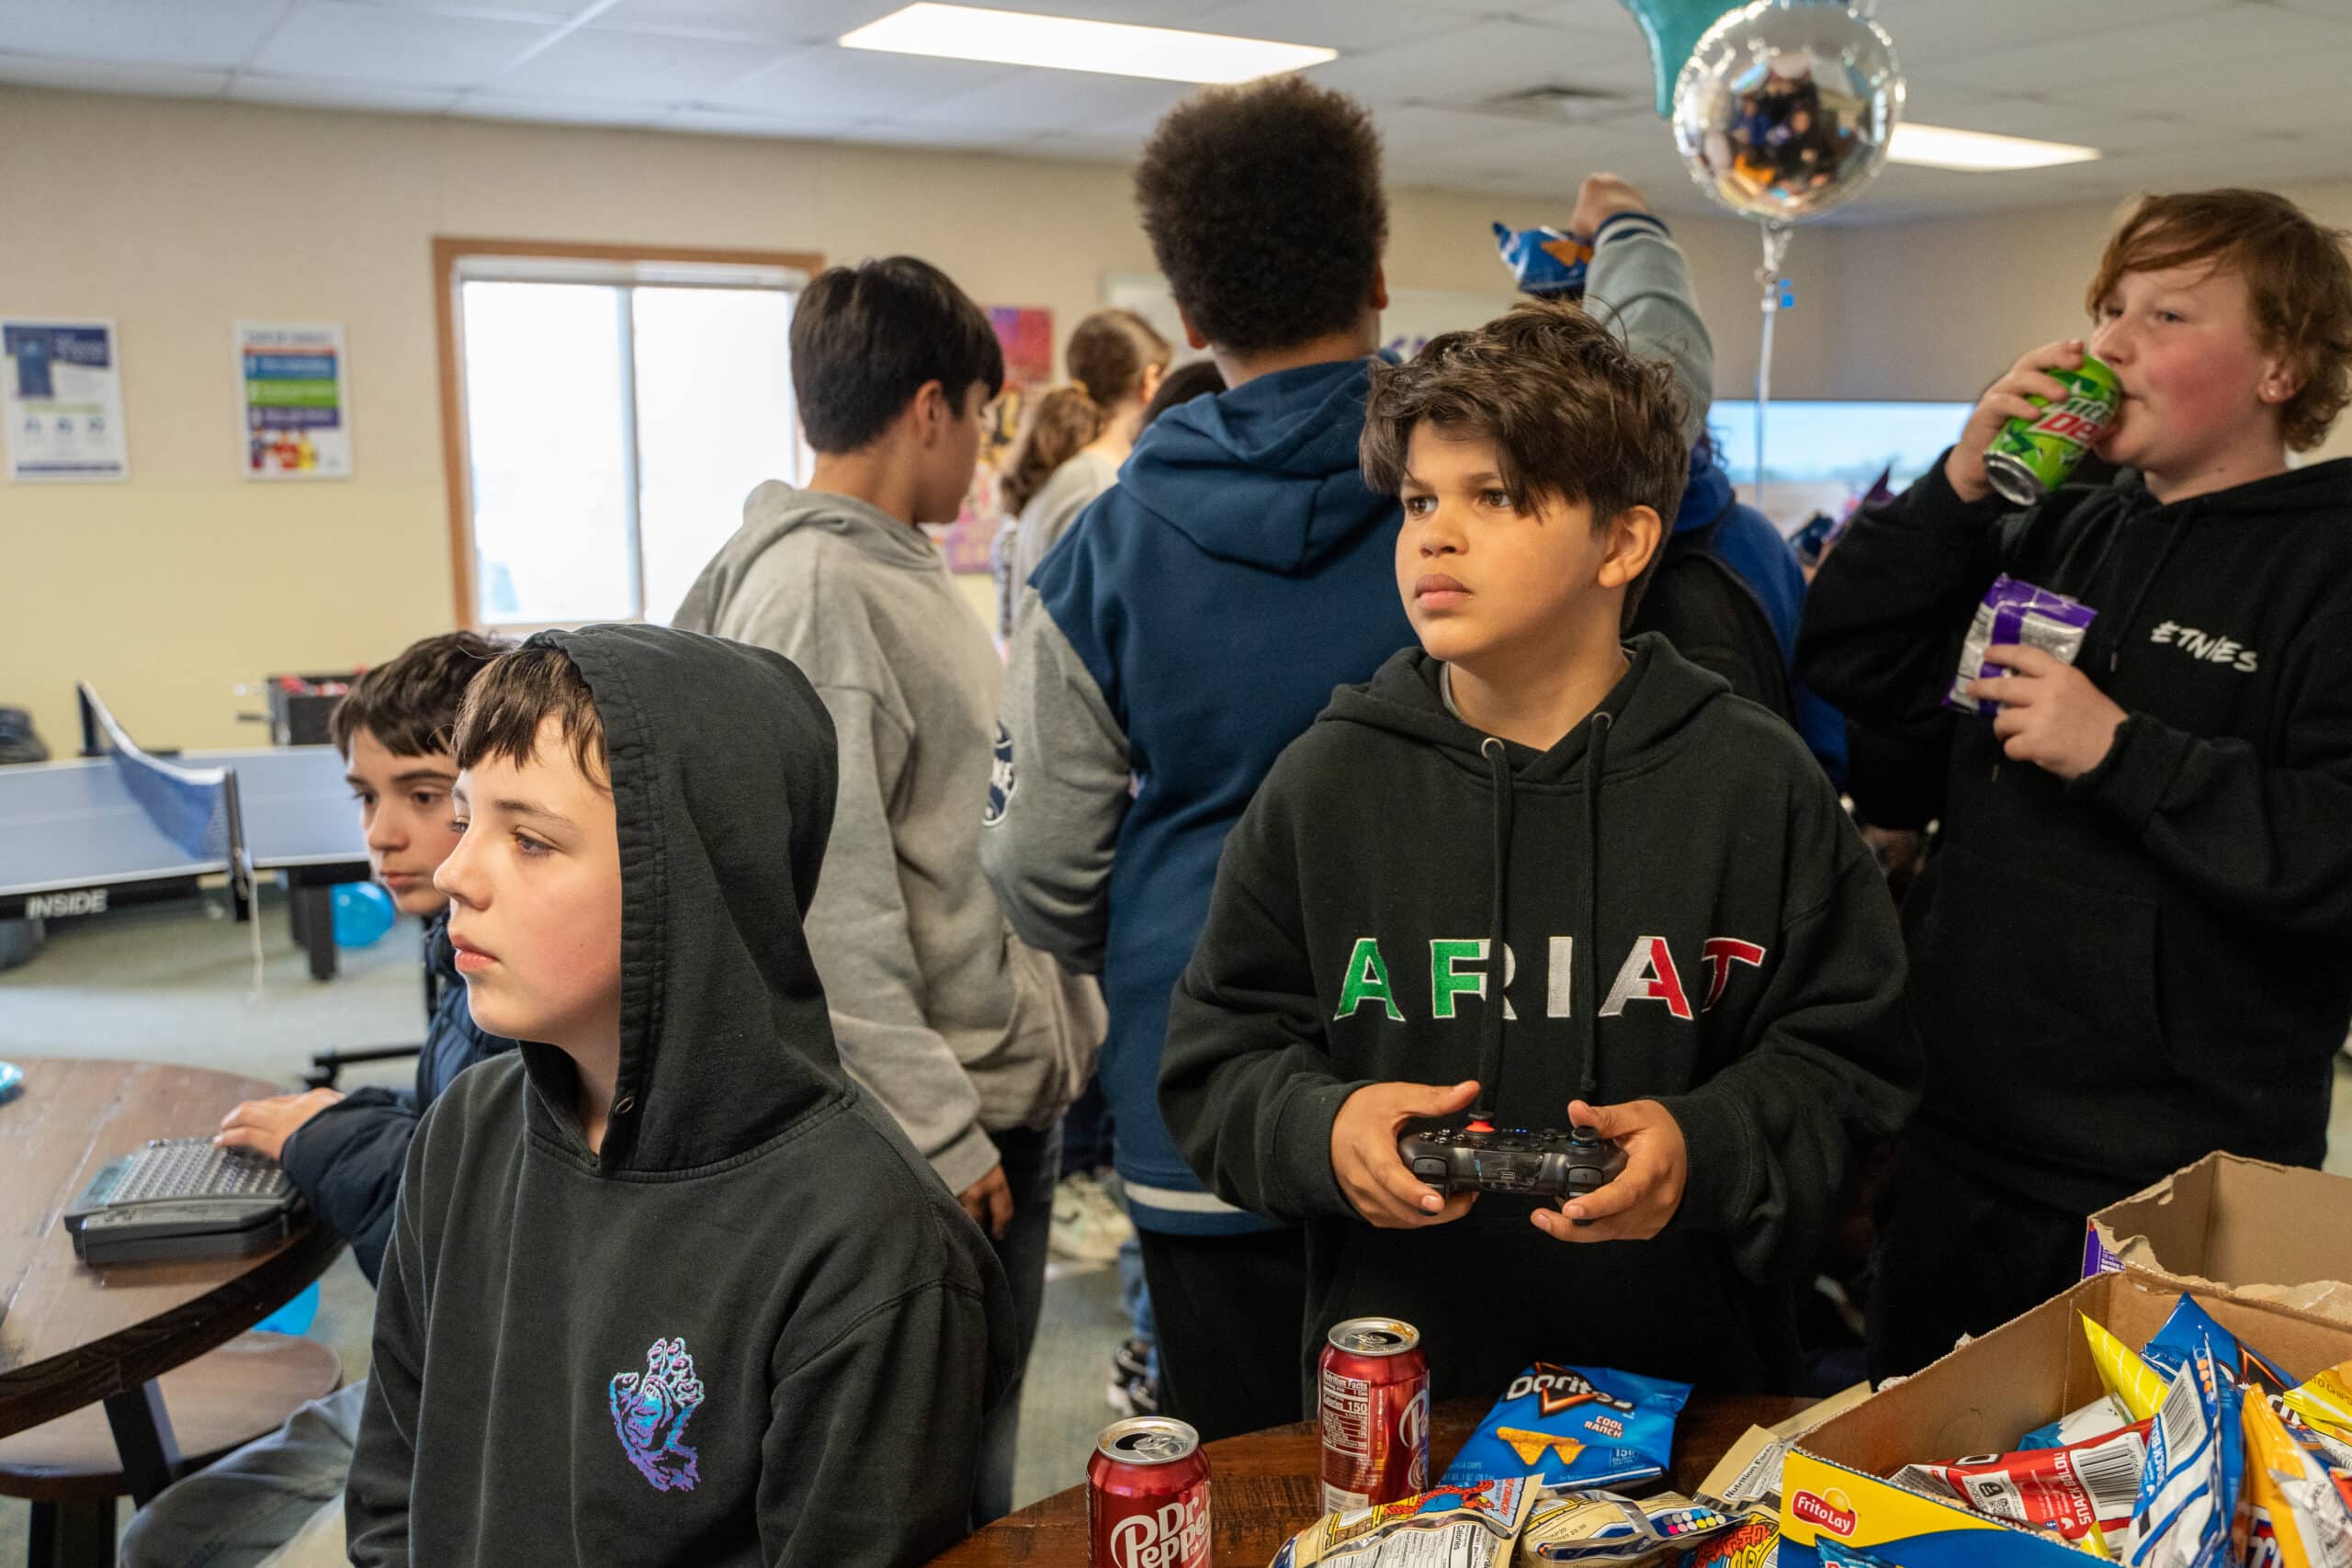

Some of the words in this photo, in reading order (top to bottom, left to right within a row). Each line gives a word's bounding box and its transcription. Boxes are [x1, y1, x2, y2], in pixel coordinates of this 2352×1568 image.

[2037, 412, 2099, 440] DE
[2150, 620, 2258, 672] ETNIES
[26, 888, 108, 919] INSIDE
[1332, 935, 1767, 1022] ARIAT
[1348, 1380, 1368, 1390] Facts
[1347, 1401, 1368, 1414] 150
[1595, 1416, 1623, 1431] COOL
[1584, 1421, 1623, 1438] RANCH
[1725, 1465, 1758, 1499] Nutrition
[1157, 1496, 1200, 1543] Dr
[1797, 1495, 1829, 1521] Frito
[1827, 1510, 1851, 1533] Lay
[2068, 1486, 2093, 1526] SNACK
[1110, 1510, 1210, 1568] Peppe
[1454, 1525, 1466, 1551] Calories
